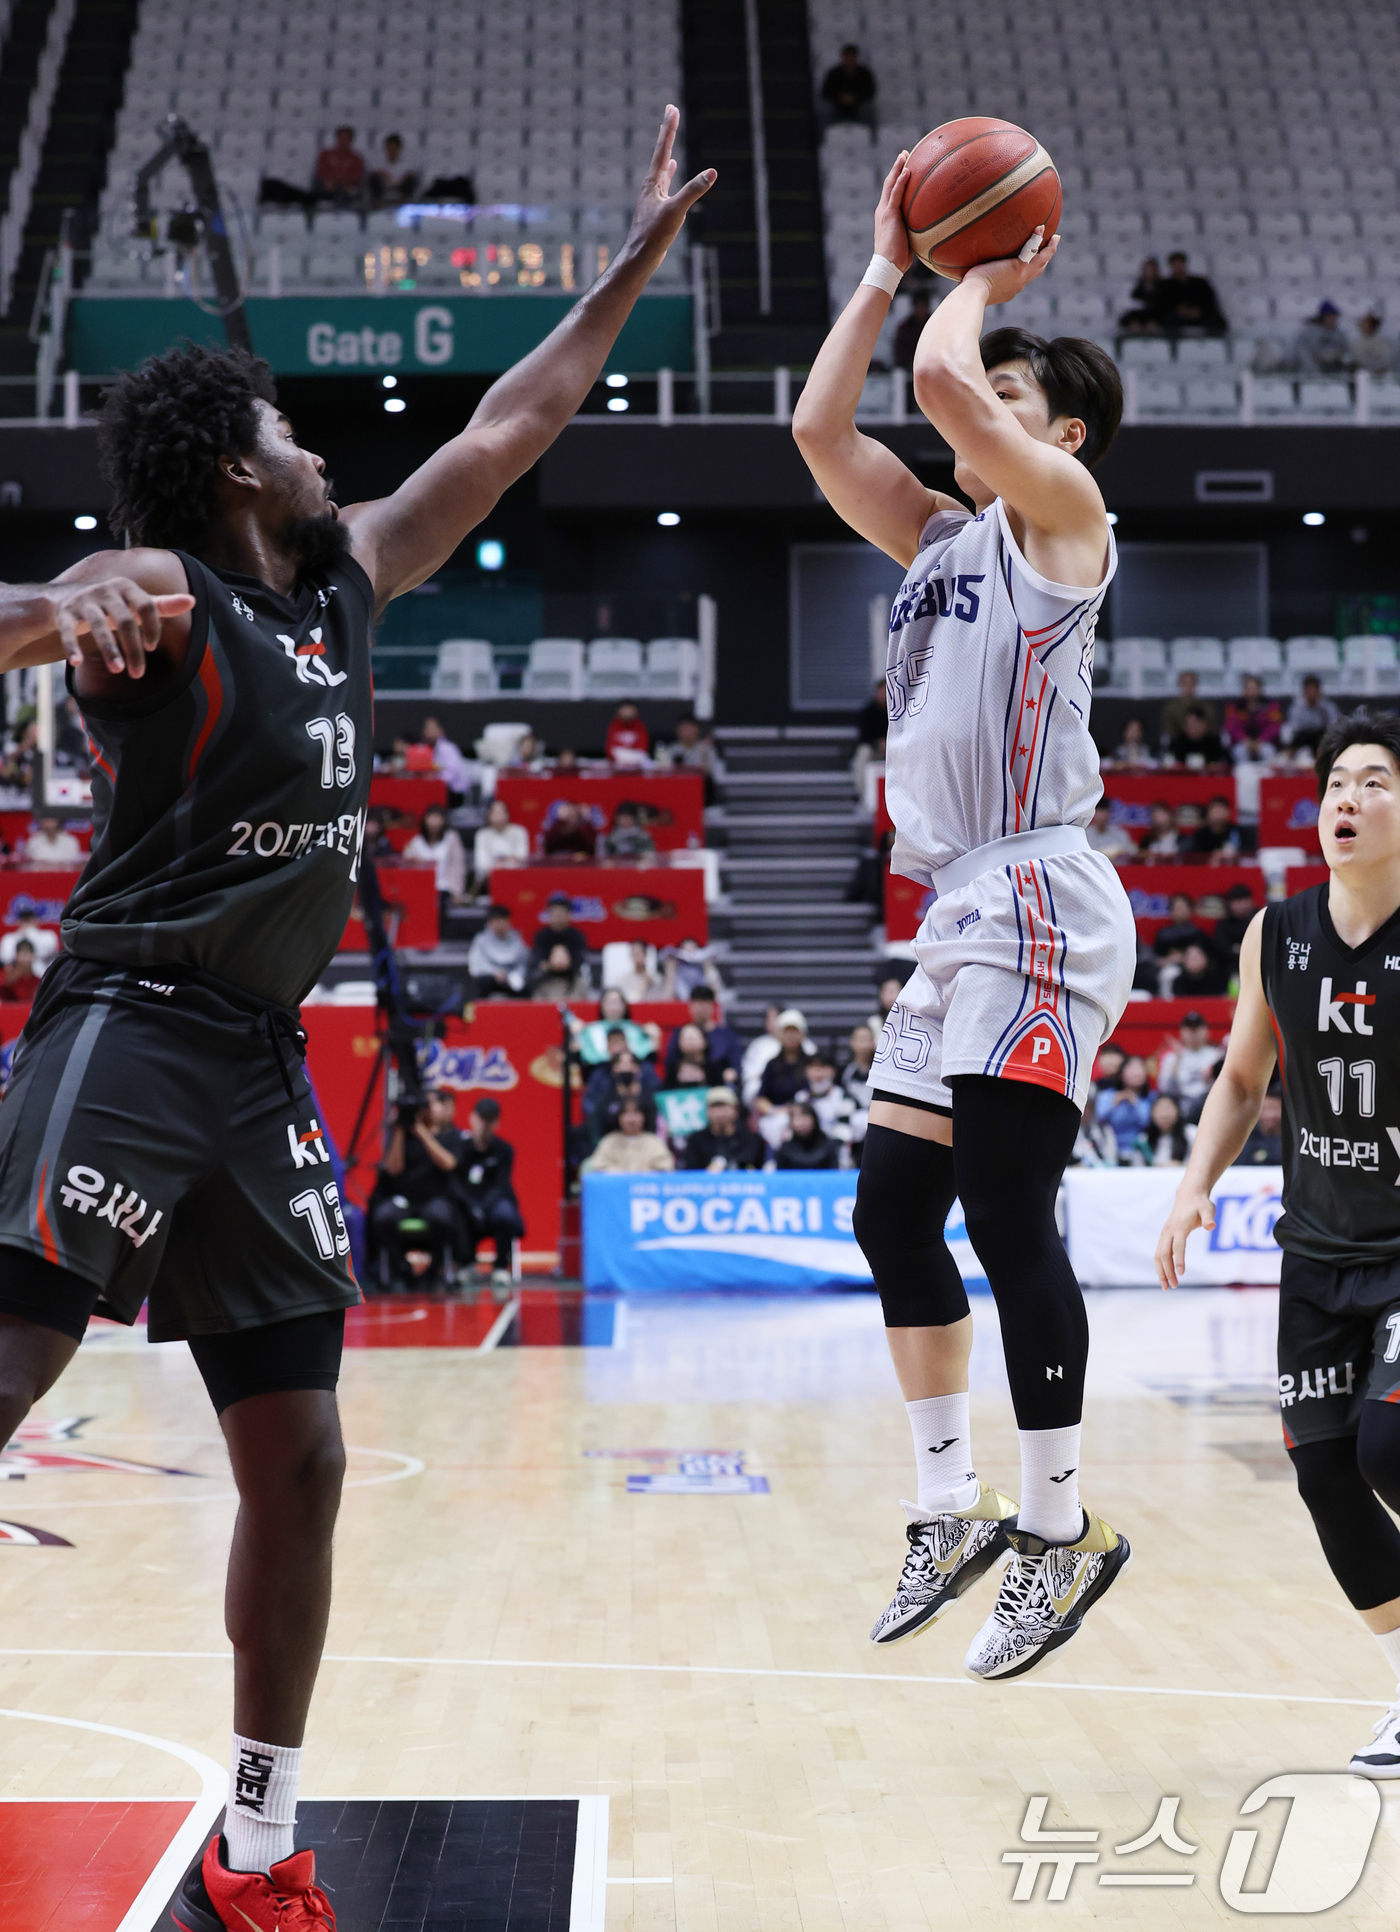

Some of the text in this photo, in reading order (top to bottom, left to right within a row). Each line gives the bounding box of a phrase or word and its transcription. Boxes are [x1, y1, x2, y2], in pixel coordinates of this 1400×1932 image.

[307, 306, 453, 366] Gate G
[305, 712, 356, 789] 13
[1318, 977, 1376, 1036] kt
[1032, 1036, 1051, 1064] P
[1317, 1056, 1376, 1118] 11
[287, 1118, 330, 1169] kt
[59, 1164, 164, 1248] 유사나
[289, 1182, 350, 1260] 13
[629, 1196, 824, 1234] POCARI
[1280, 1361, 1355, 1409] 유사나
[235, 1748, 274, 1816] HDEX
